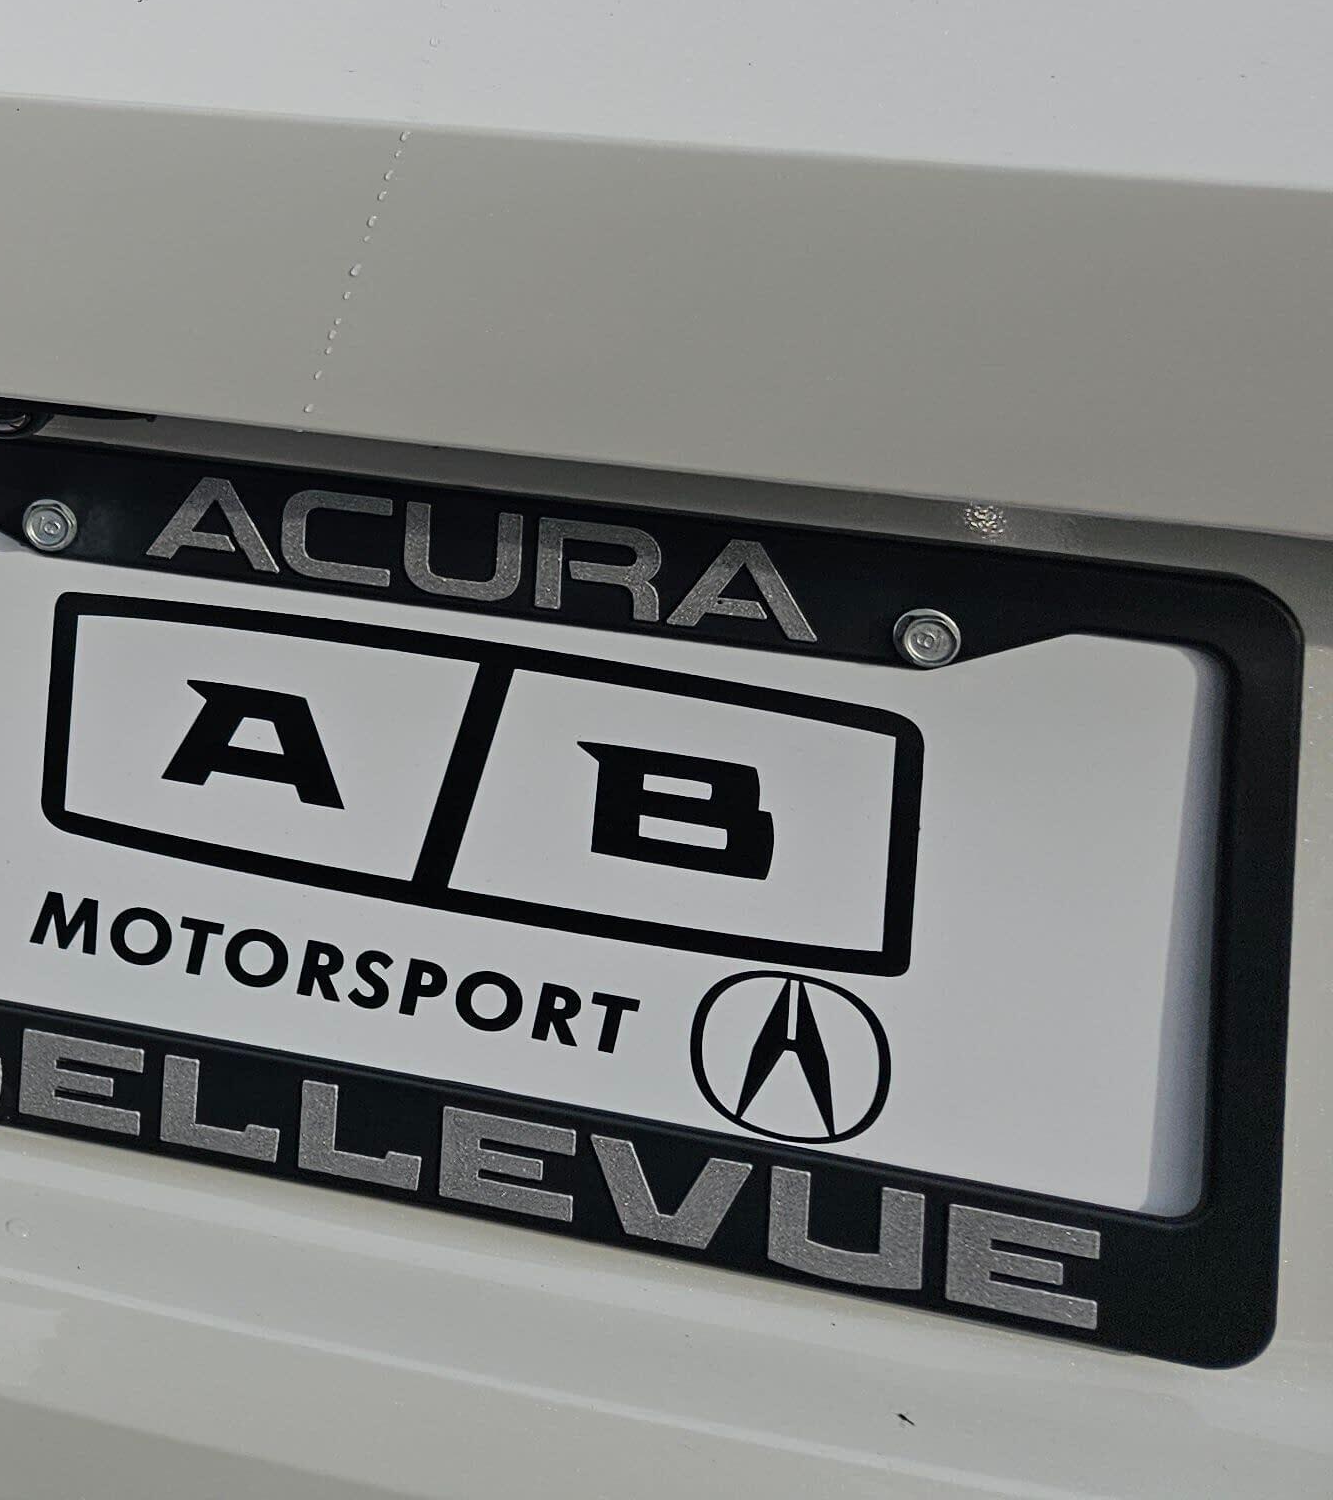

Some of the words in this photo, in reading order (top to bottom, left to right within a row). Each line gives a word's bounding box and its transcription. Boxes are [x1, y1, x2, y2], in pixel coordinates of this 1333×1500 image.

[146, 477, 818, 641] ACURA
[162, 680, 344, 809] A
[576, 741, 774, 880] B
[30, 891, 640, 1053] MOTORSPORT
